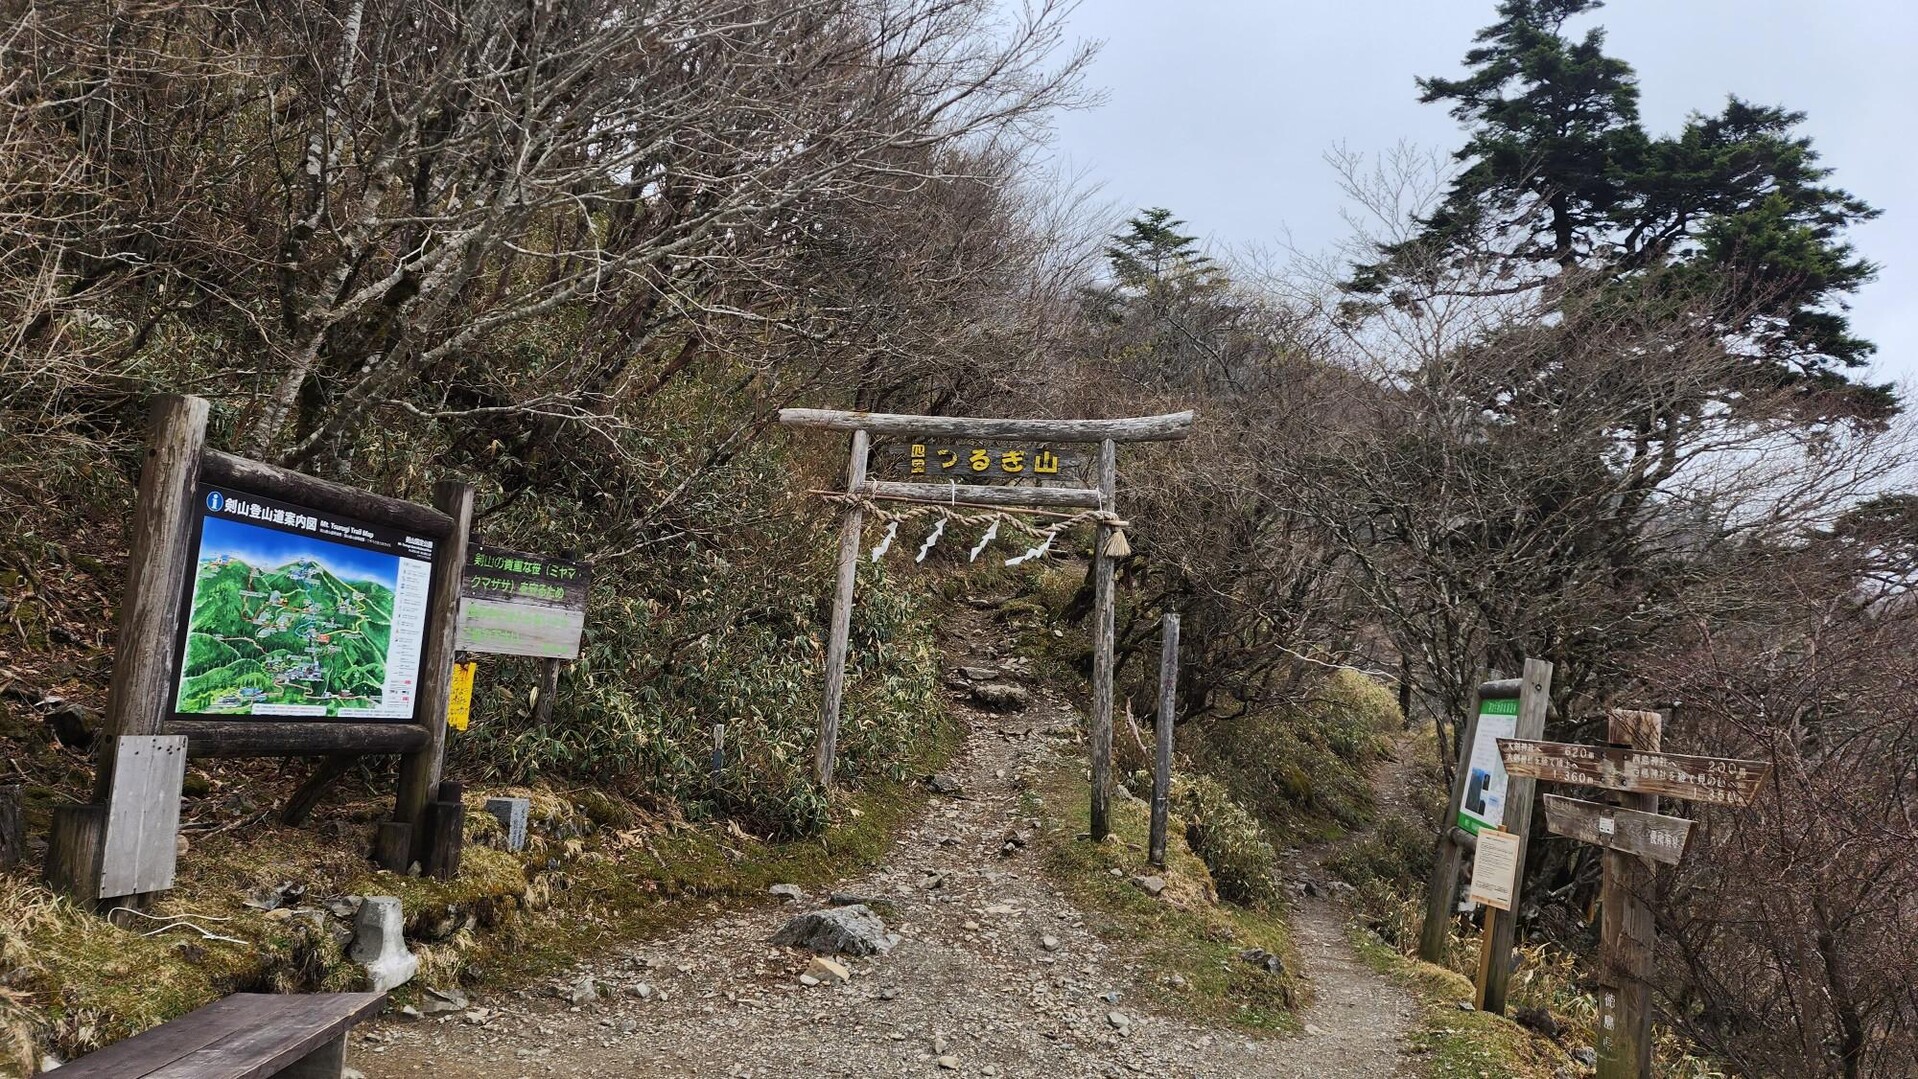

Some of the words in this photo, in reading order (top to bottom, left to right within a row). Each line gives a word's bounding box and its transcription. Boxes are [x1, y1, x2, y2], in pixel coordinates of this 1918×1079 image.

[936, 448, 1059, 474] つるぎ山
[224, 497, 318, 532] 剣山登山道案内図
